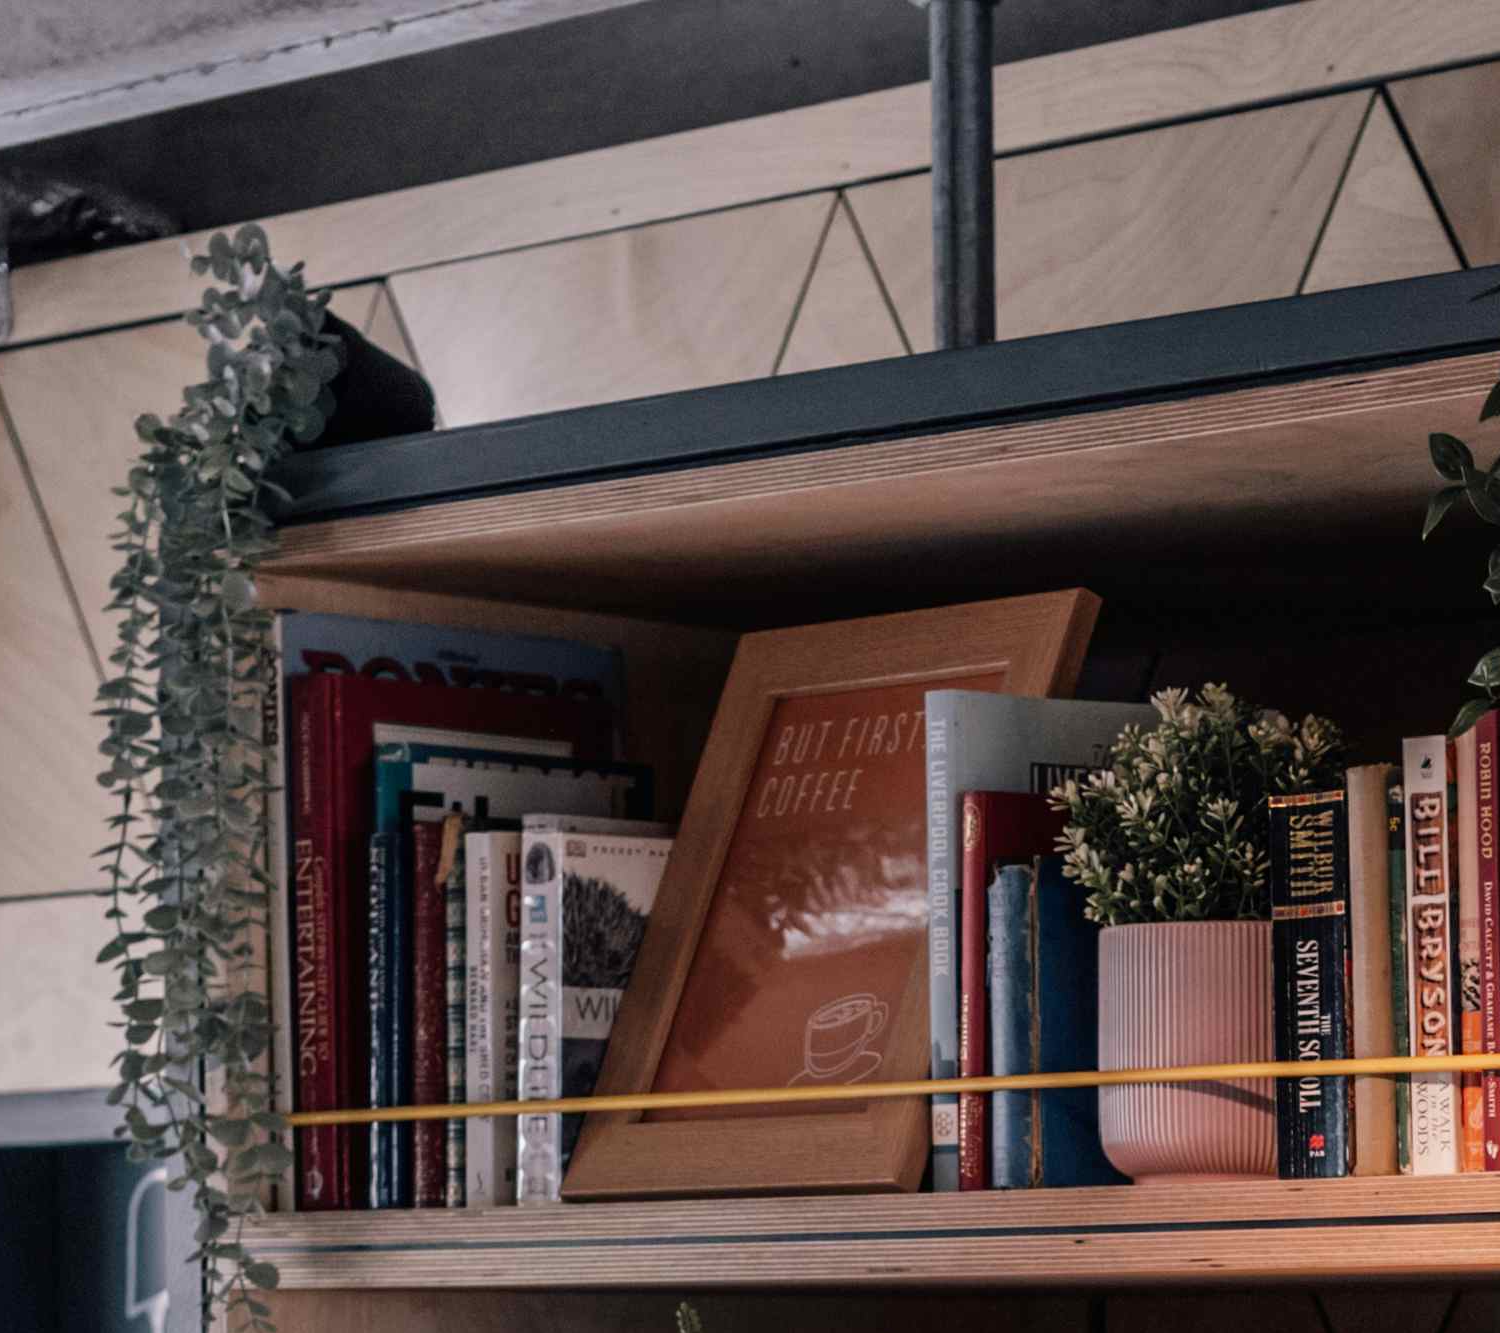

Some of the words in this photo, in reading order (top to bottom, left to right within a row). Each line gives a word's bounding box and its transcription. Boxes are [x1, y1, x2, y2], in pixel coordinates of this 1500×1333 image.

[774, 720, 832, 766] BUT
[928, 719, 945, 753] THE
[758, 769, 862, 818] COFFEE
[932, 759, 948, 861] LIVERPOOL
[1289, 816, 1307, 896] SMITH
[1317, 810, 1332, 895] WILBUR
[1413, 797, 1443, 896] BILL
[933, 869, 948, 917] COOK
[932, 925, 949, 977] BOOK
[1296, 940, 1321, 1034] SEVENTH
[1415, 907, 1446, 1057] BRYSON
[1416, 1080, 1428, 1155] WOODS
